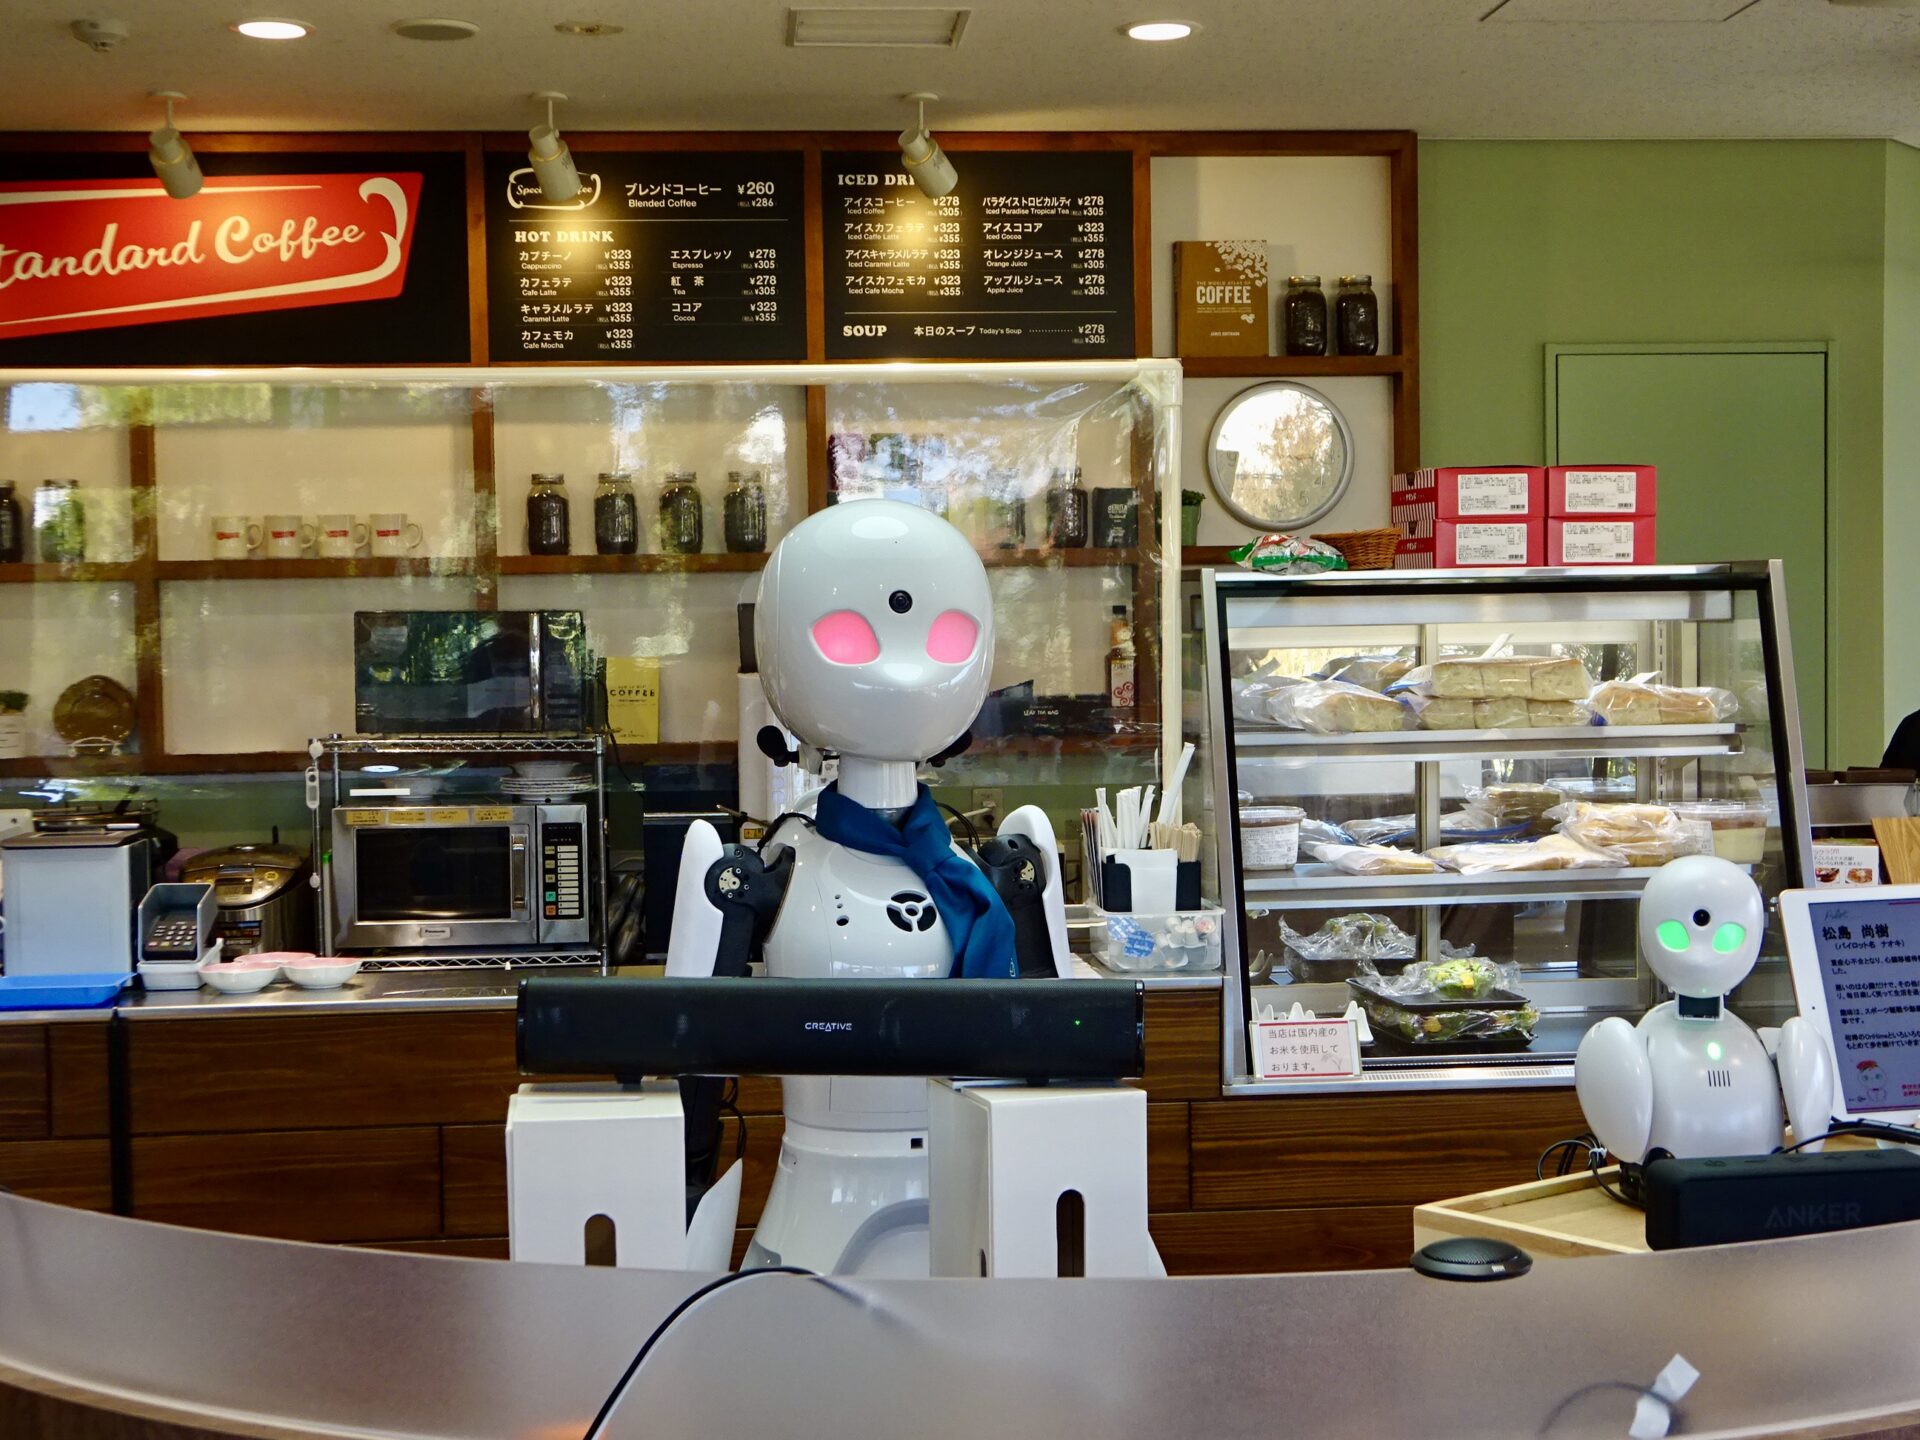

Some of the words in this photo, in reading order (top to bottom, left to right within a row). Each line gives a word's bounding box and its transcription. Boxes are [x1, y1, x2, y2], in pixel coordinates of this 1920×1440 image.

[837, 174, 879, 186] ICED
[625, 183, 722, 196] ブレンドコーヒー
[737, 181, 774, 196] ¥260
[628, 199, 665, 207] Blended
[667, 199, 697, 207] Coffee
[844, 198, 916, 207] アイスコーヒー
[933, 196, 960, 206] ¥278
[982, 197, 1071, 207] パラダイストロピカルティ
[1077, 196, 1104, 206] ¥278
[1031, 208, 1056, 216] Tropical
[844, 223, 924, 233] アイスカフェラテ
[933, 223, 960, 232] ¥323
[983, 223, 1043, 233] アイスココア
[1078, 223, 1104, 232] ¥323
[515, 231, 551, 242] HOT
[557, 231, 614, 242] DRINK
[0, 218, 206, 290] tandard
[214, 215, 366, 266] Coffee
[604, 249, 631, 259] ¥323
[670, 250, 732, 260] エスプレッソ
[749, 249, 776, 259] ¥278
[845, 249, 928, 260] アイスキャラメルラテ
[934, 249, 960, 259] ¥323
[983, 249, 1063, 259] オレンジジュース
[1078, 249, 1104, 259] ¥278
[520, 277, 572, 288] カフェラテ
[605, 276, 632, 286] ¥323
[750, 275, 777, 285] ¥278
[845, 276, 926, 286] アイスカフェモカ
[934, 276, 960, 285] ¥323
[984, 276, 1063, 286] アップルジュース
[1079, 275, 1105, 285] ¥278
[673, 288, 686, 296] Tea
[1196, 286, 1251, 304] COFFEE
[520, 304, 594, 314] キャラメルラテ
[605, 303, 633, 312] ¥323
[672, 302, 703, 313] ココア
[750, 302, 777, 312] ¥323
[673, 314, 696, 322] Cocoa
[606, 329, 633, 339] ¥323
[843, 325, 888, 337] SOUP
[913, 325, 976, 337] 本日のスープ
[1078, 325, 1104, 334] ¥278
[521, 330, 574, 341] カフェモカ
[1822, 925, 1851, 940] 松島
[1862, 924, 1889, 938] 尚樹
[805, 1022, 853, 1032] CREATIVE
[1268, 1027, 1338, 1040] 当店は国内産の
[1270, 1043, 1340, 1055] お米を使用して
[1271, 1061, 1317, 1073] おります。
[1764, 1202, 1862, 1229] ANKER
